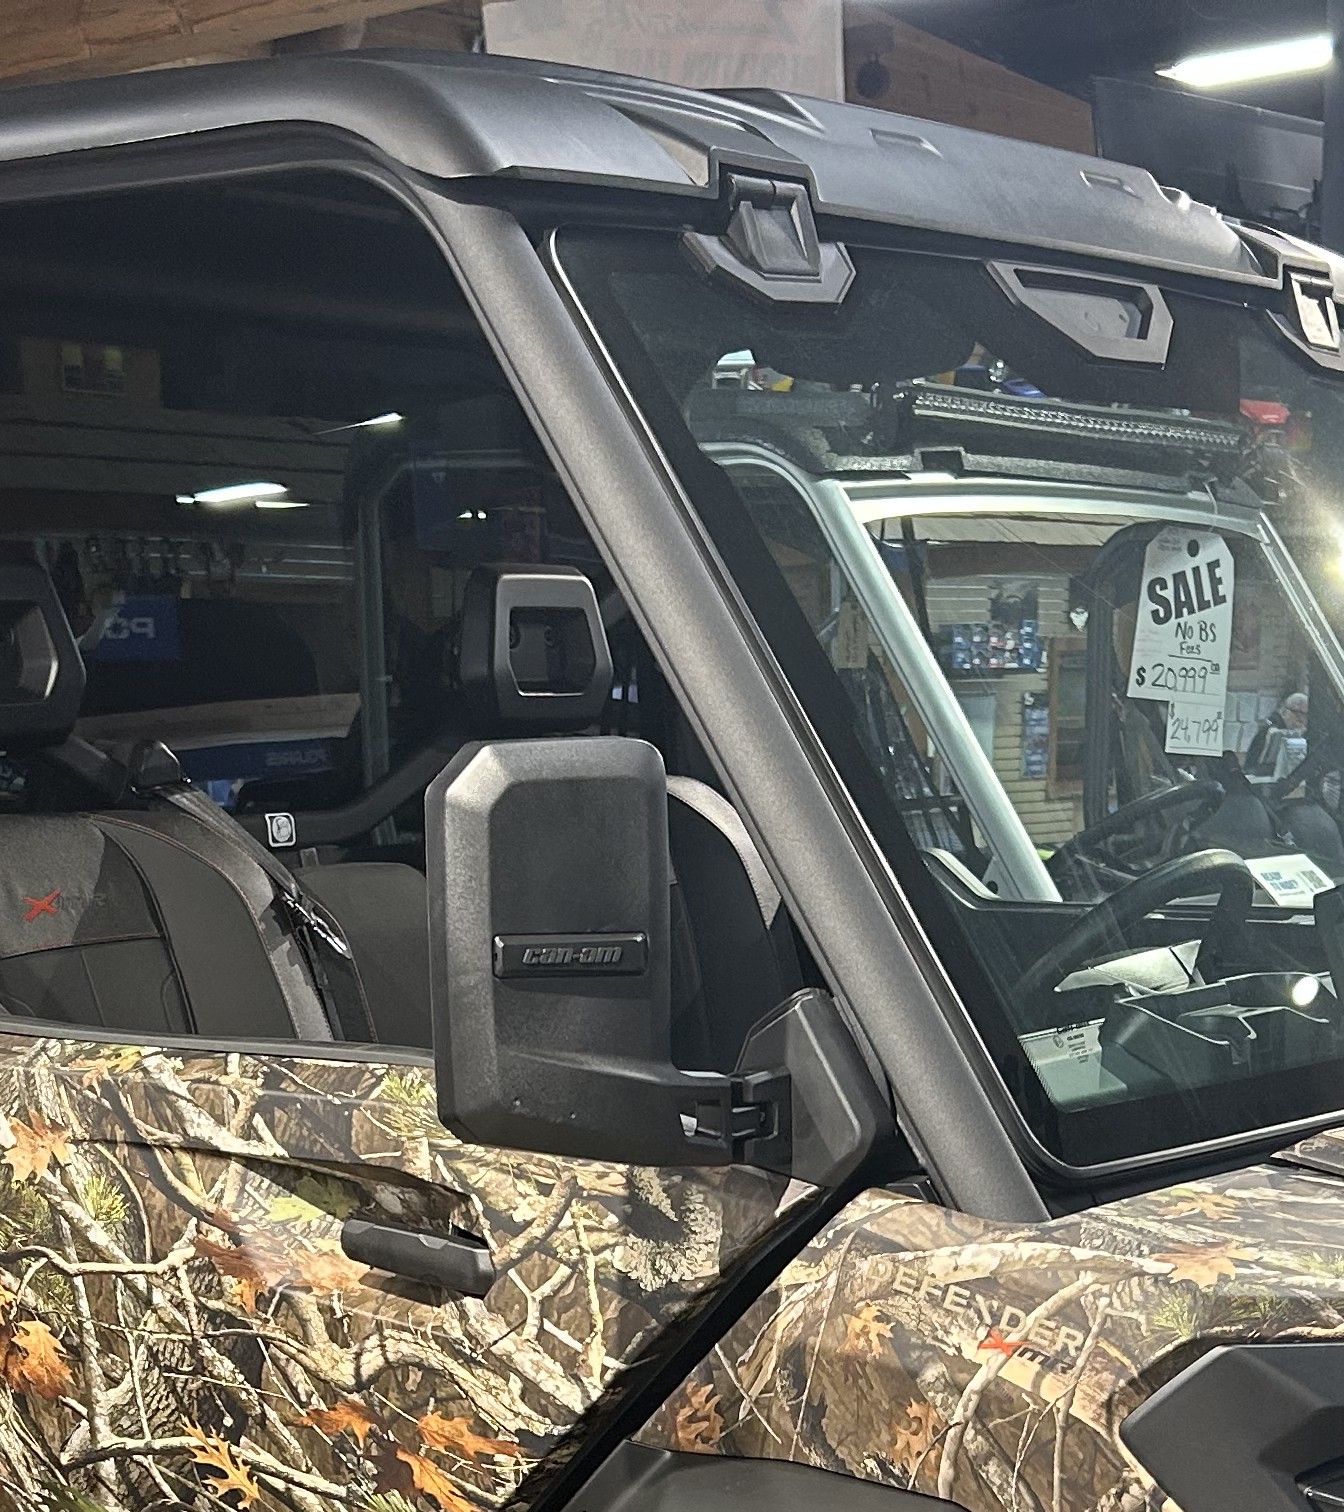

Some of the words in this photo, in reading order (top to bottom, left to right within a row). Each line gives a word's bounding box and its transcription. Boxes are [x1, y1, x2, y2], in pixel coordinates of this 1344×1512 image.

[1147, 558, 1227, 626] SALE
[1174, 621, 1194, 640] No
[1198, 621, 1218, 643] BS
[522, 947, 623, 966] can-am
[865, 1256, 1086, 1358] DEFENDER
